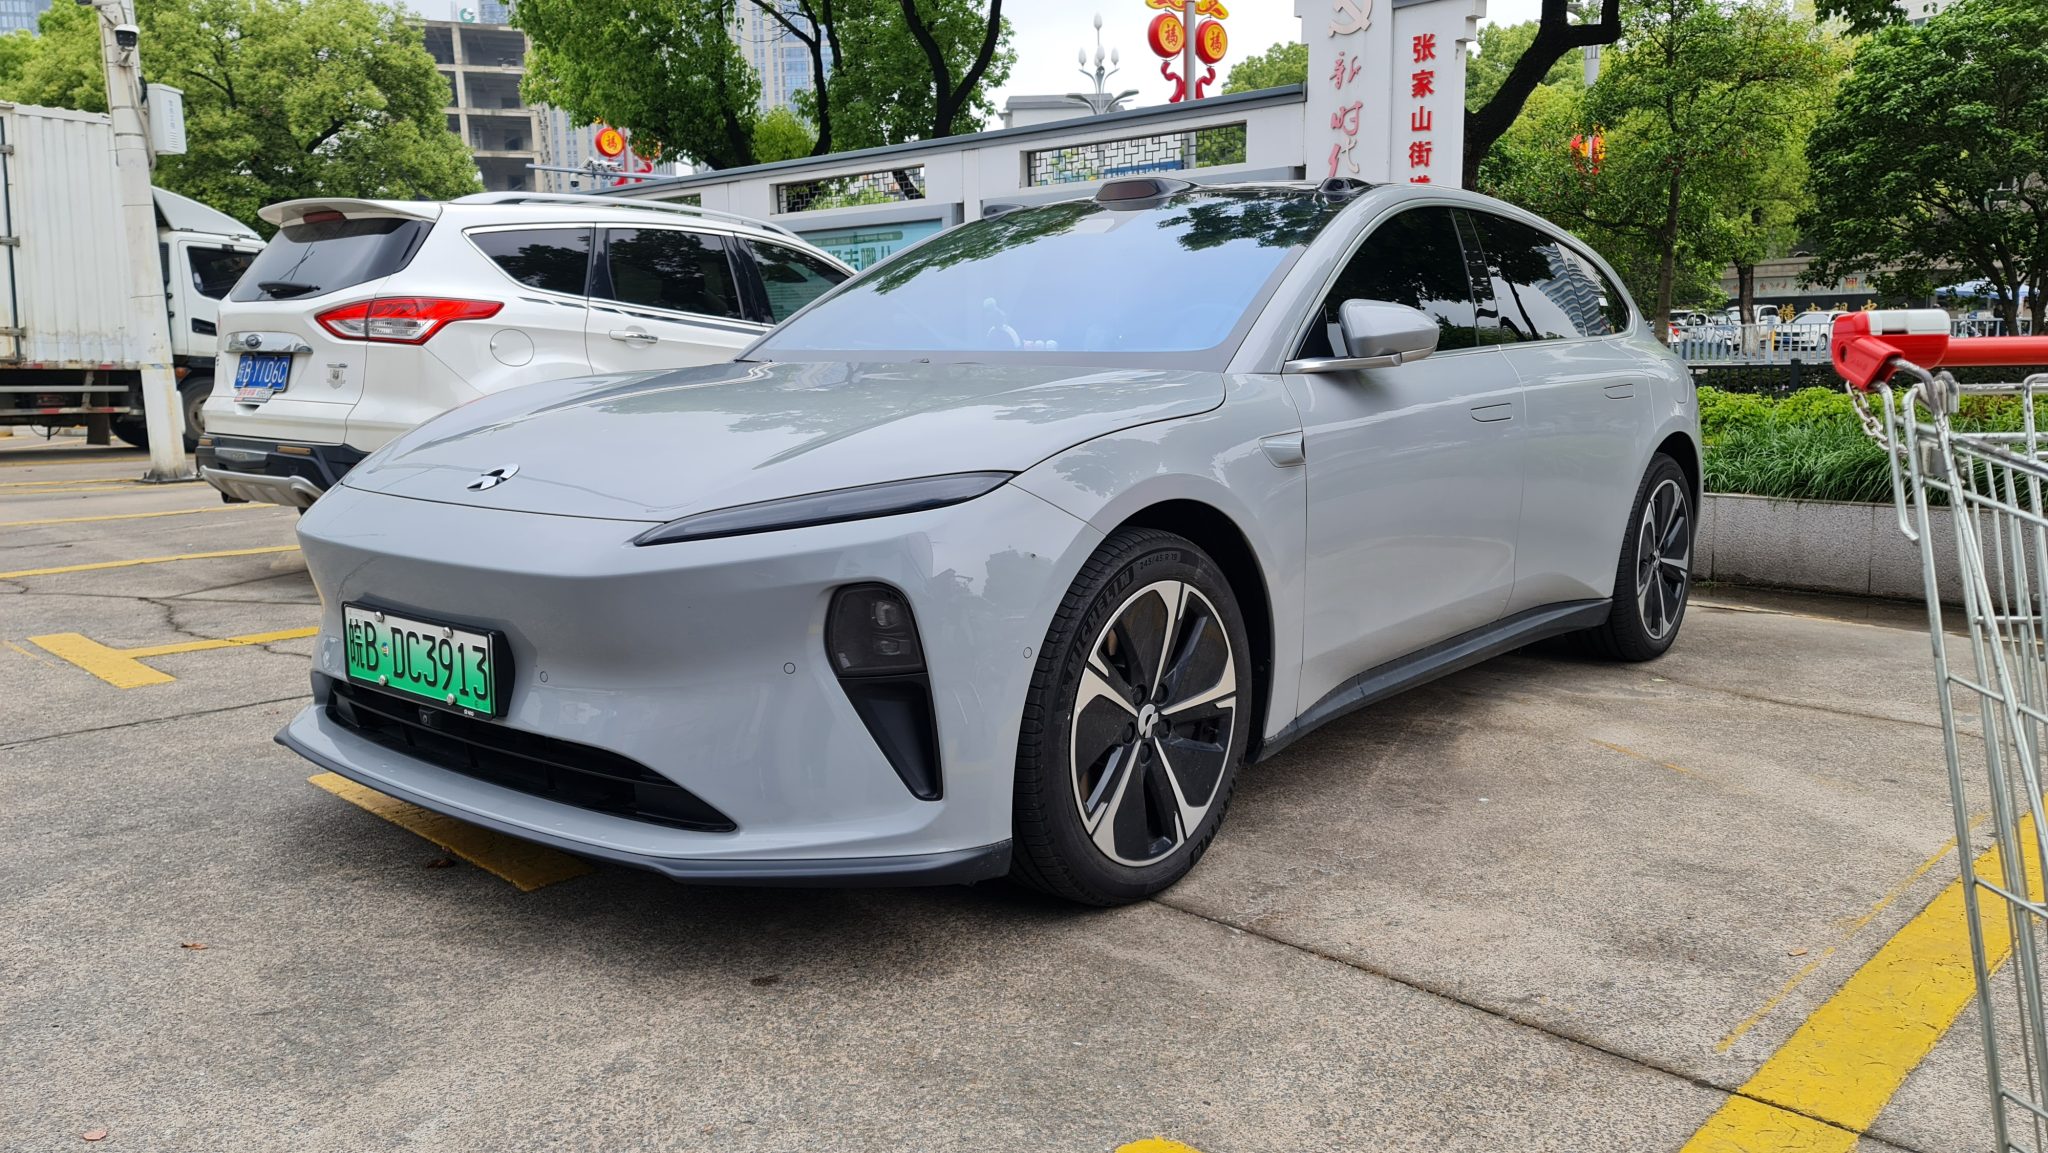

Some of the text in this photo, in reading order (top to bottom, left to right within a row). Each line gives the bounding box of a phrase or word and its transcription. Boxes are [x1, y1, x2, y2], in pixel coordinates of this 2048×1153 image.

[1165, 23, 1178, 47] 福
[1210, 30, 1222, 53] 福
[1066, 567, 1134, 672] MICHELIN
